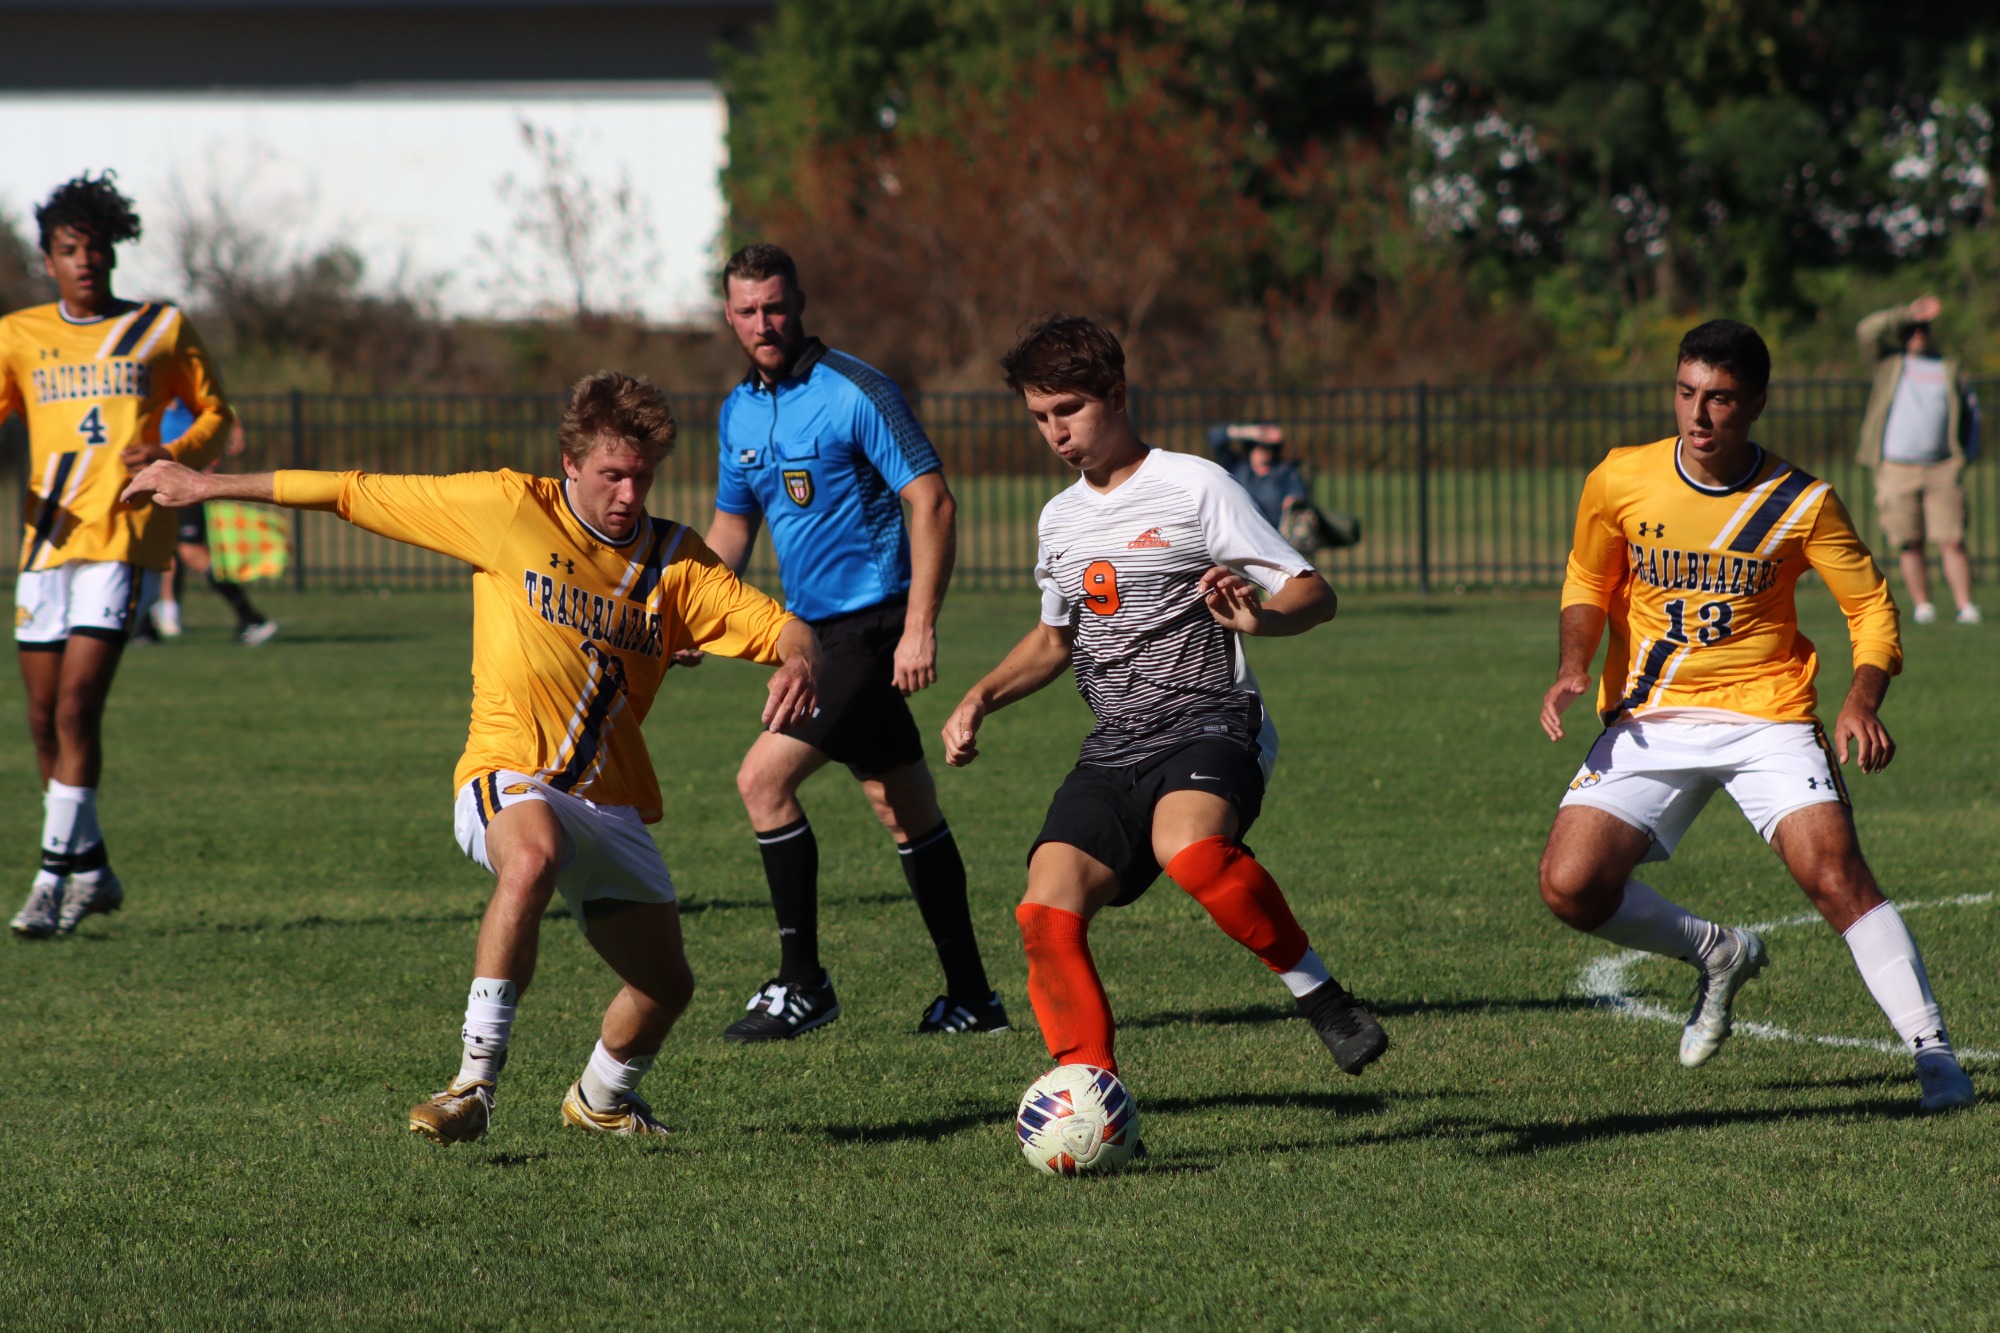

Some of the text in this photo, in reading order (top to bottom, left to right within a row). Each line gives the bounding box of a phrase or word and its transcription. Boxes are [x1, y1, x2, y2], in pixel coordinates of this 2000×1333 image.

[79, 405, 107, 446] 4
[1083, 560, 1121, 616] 9
[1664, 598, 1733, 647] 13
